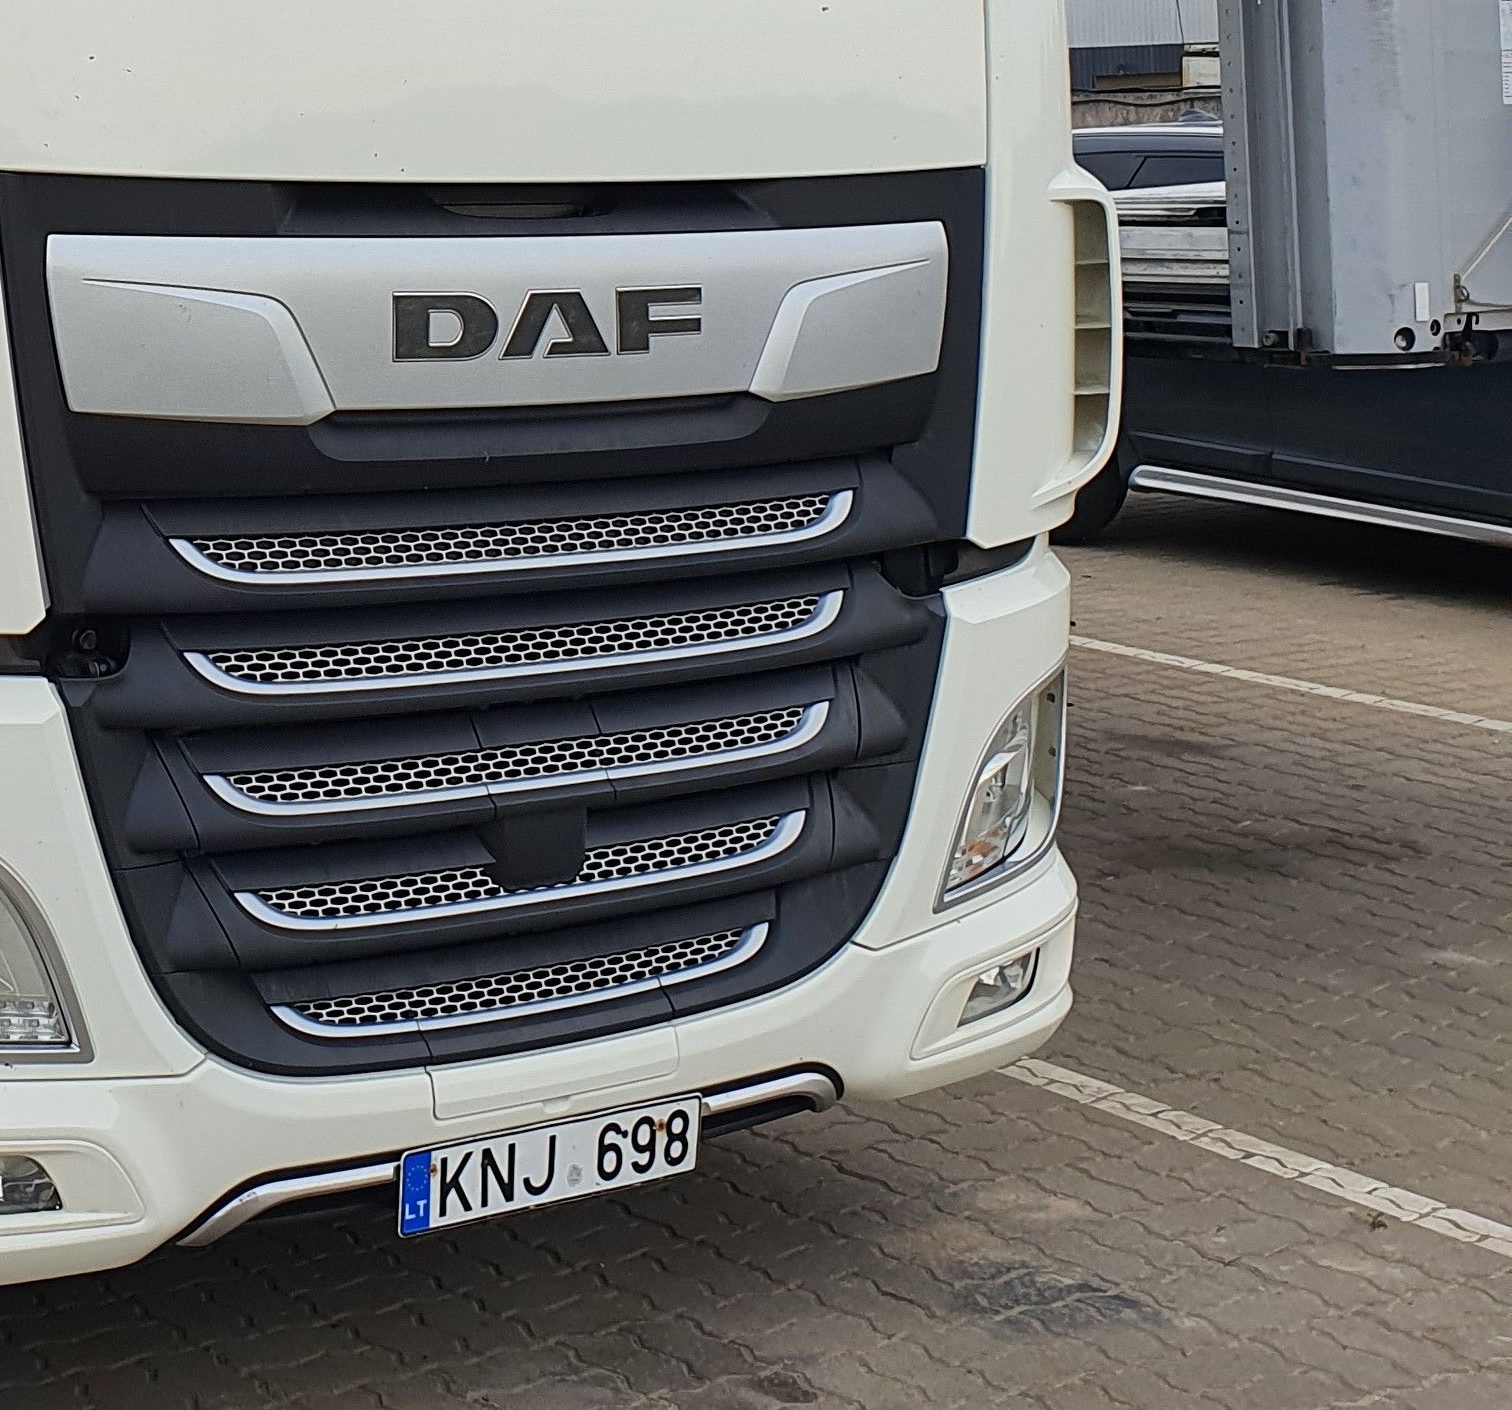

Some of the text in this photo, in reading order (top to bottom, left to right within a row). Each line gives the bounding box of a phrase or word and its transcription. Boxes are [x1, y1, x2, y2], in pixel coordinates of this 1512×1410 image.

[391, 283, 703, 363] DAF
[438, 1108, 690, 1218] KNJ 698
[404, 1199, 428, 1221] LT
